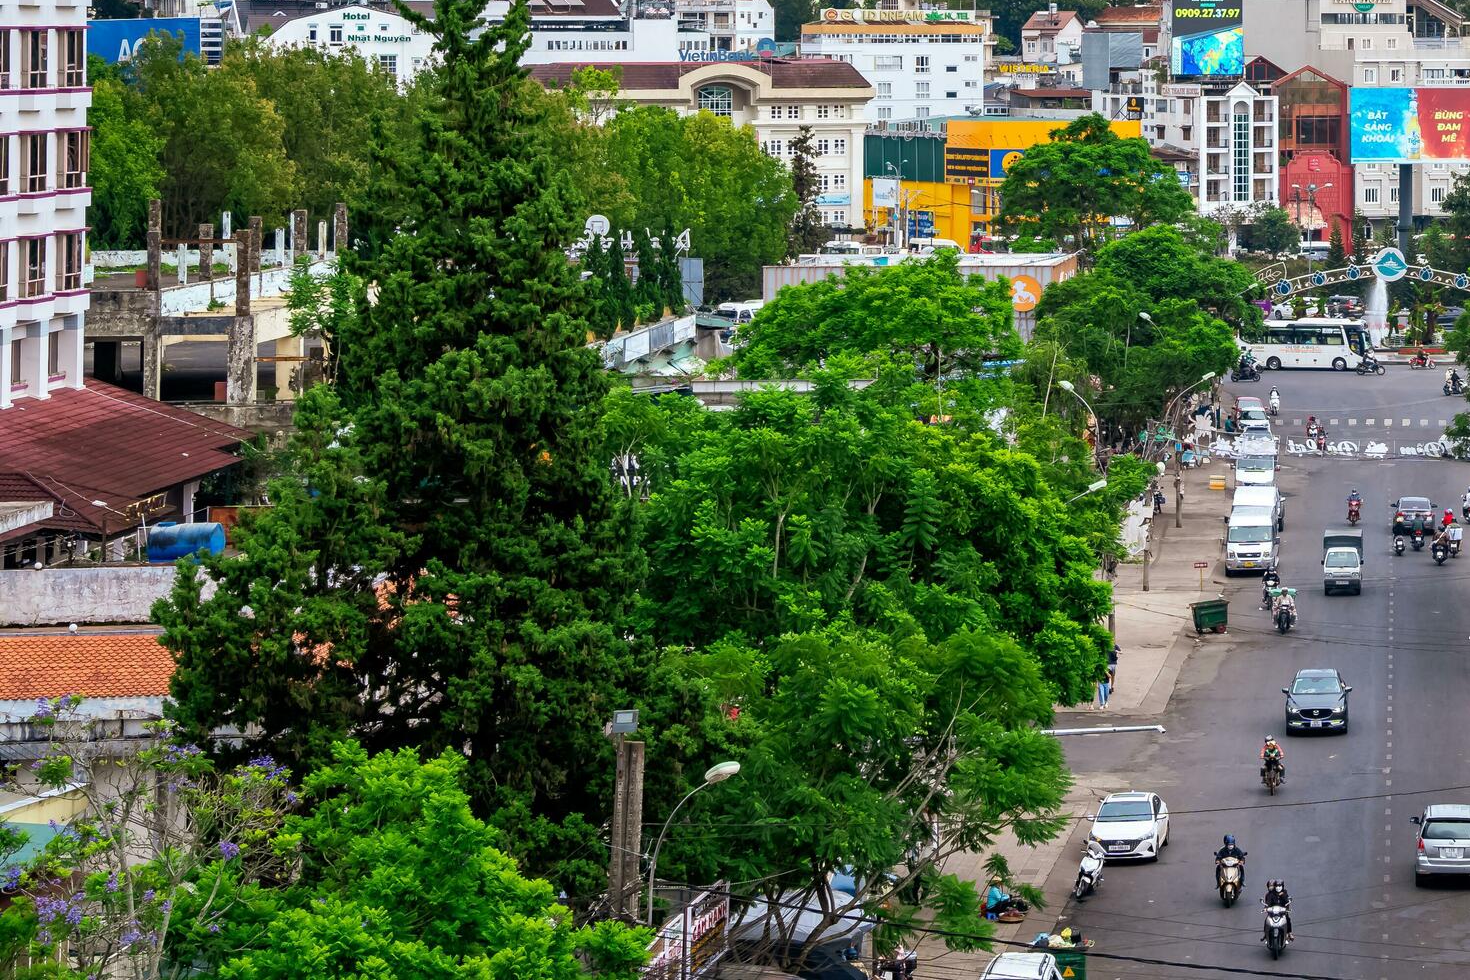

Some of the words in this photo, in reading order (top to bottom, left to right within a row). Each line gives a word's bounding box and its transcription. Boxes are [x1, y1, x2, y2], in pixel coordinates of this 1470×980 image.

[879, 10, 925, 22] DREAM
[944, 12, 970, 21] HOTEL
[1175, 8, 1240, 18] 0909.27.37.97
[678, 48, 755, 63] VietinBank
[999, 64, 1049, 73] WISTERIA
[1437, 123, 1461, 131] ĐAM
[1441, 133, 1457, 143] MÊ
